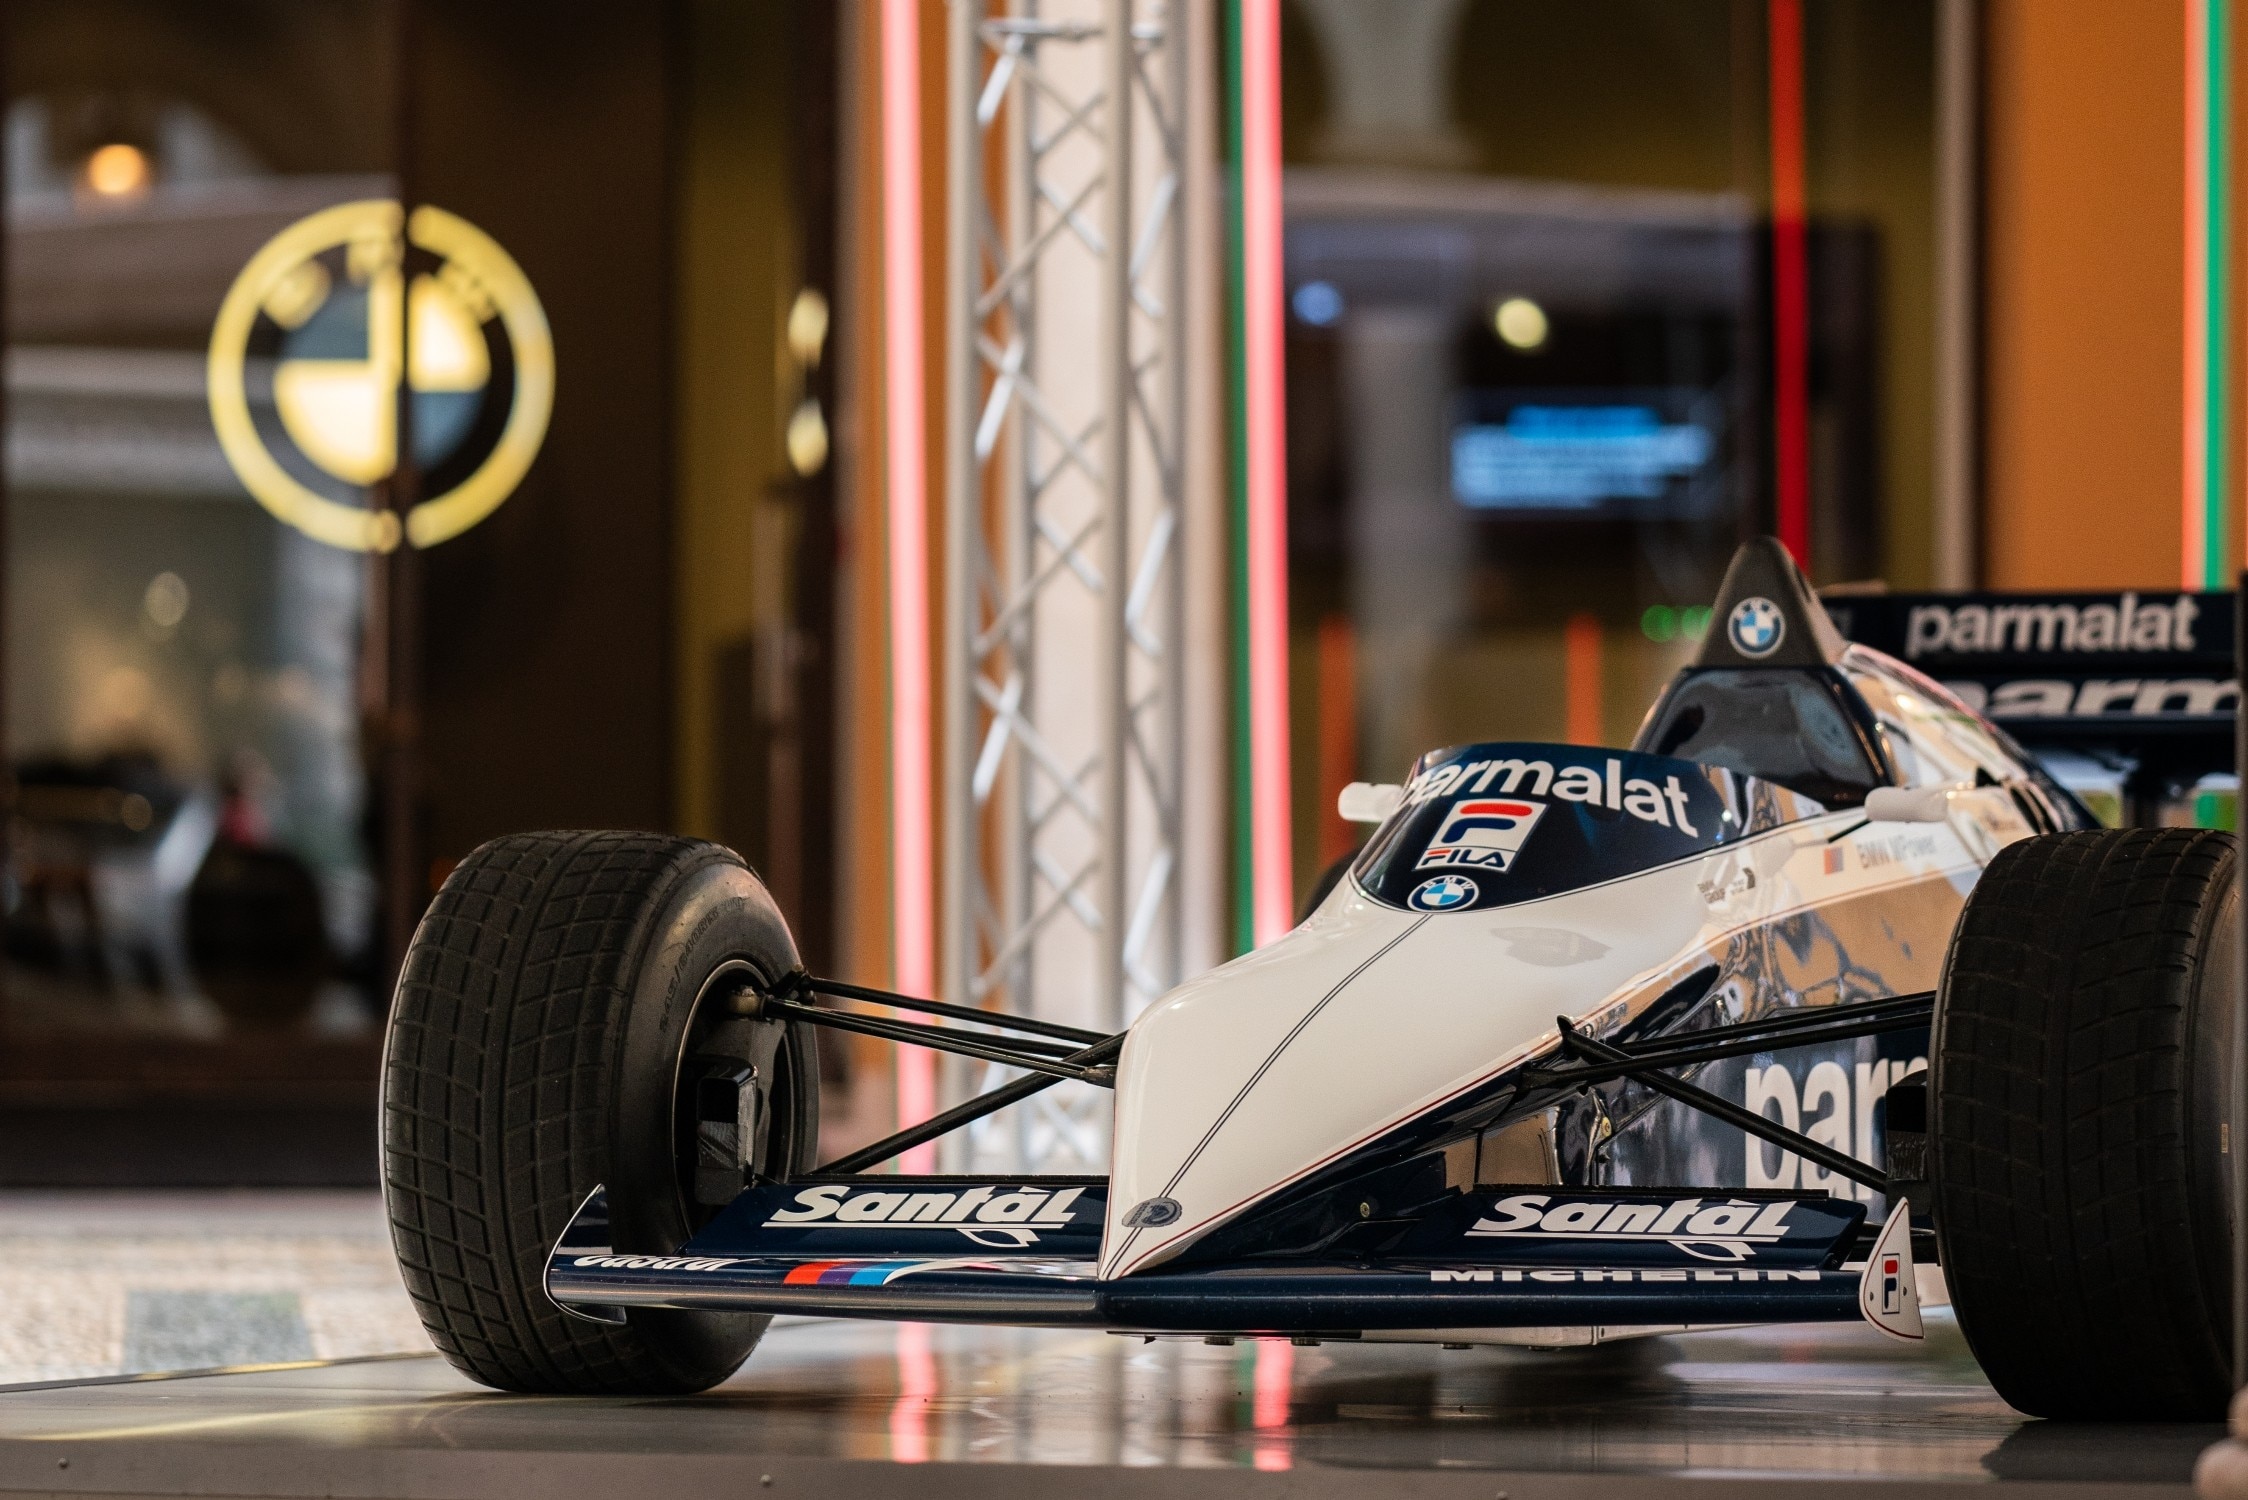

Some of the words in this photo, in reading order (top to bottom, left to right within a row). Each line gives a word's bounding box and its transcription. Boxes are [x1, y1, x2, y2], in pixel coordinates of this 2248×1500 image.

[1904, 592, 2200, 659] parmalat
[1420, 847, 1506, 868] FILA
[1430, 1269, 1821, 1282] MICHELIN
